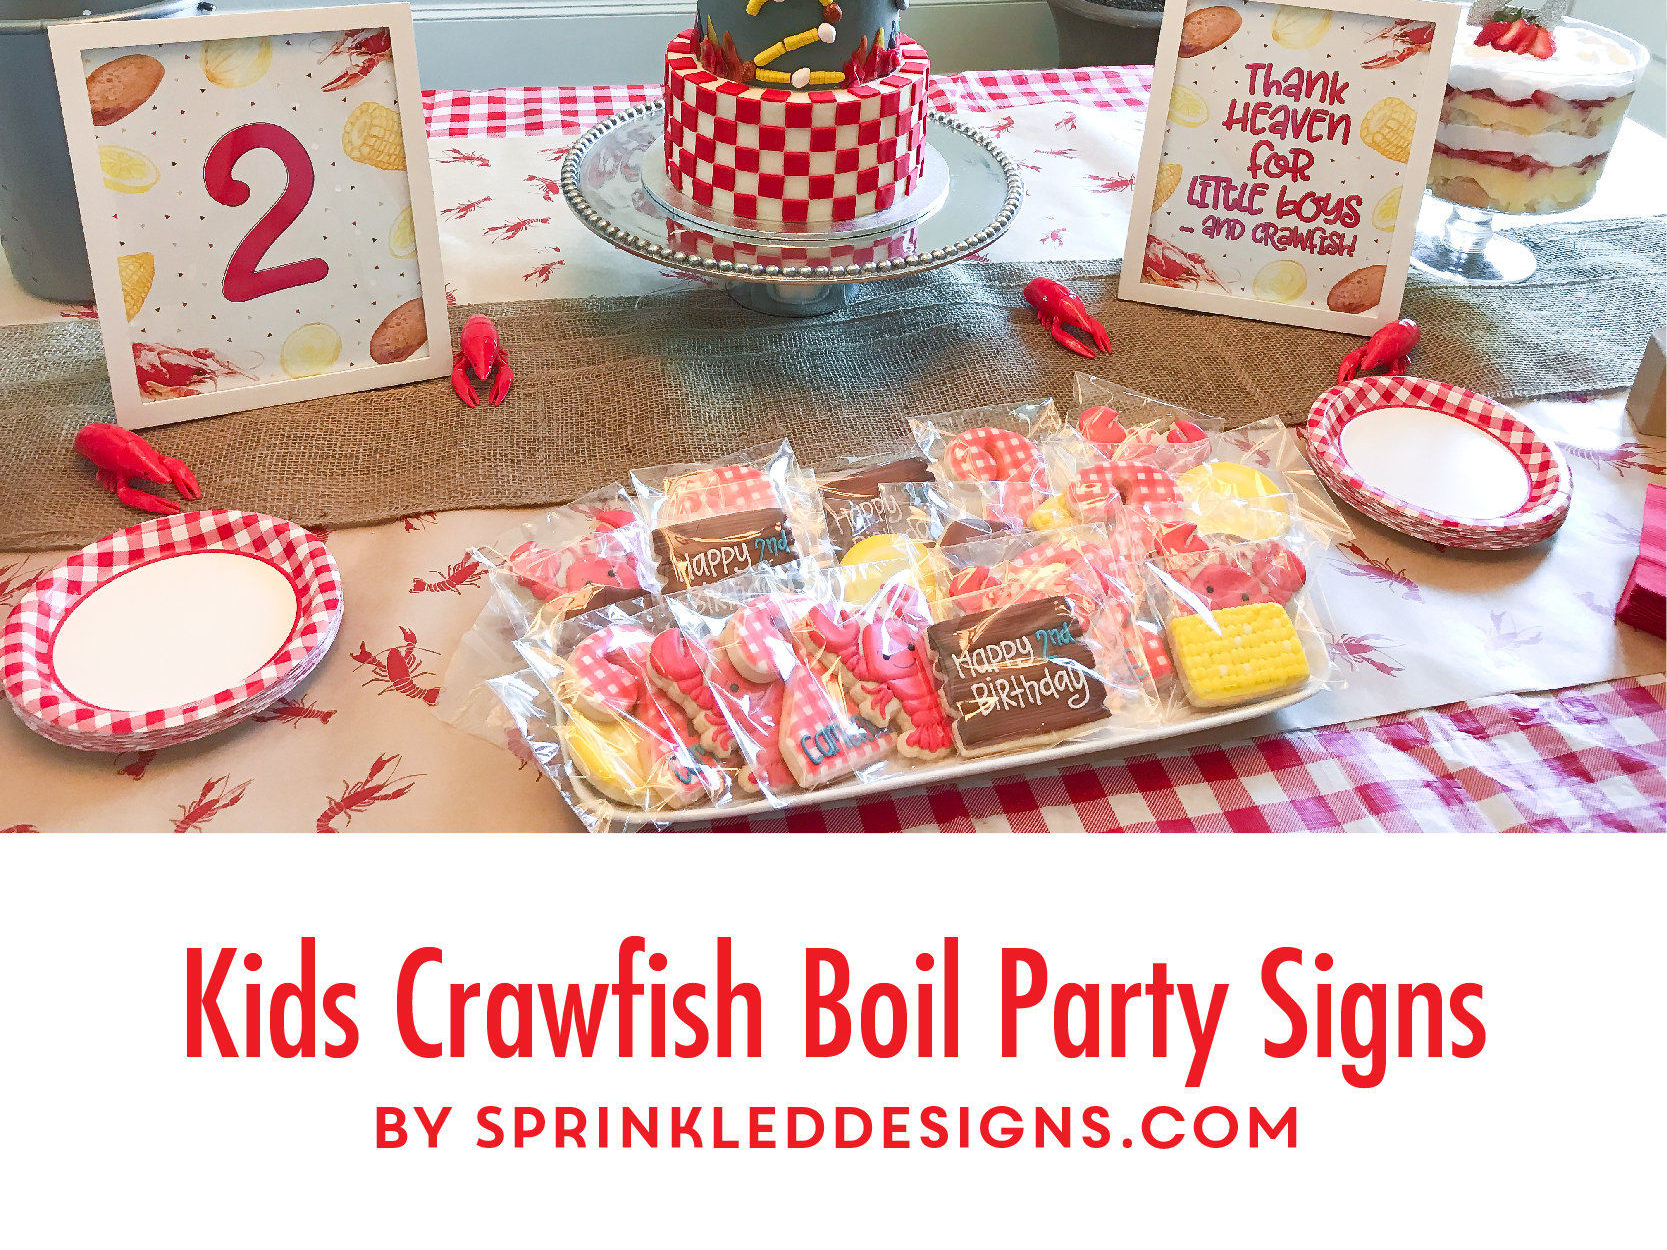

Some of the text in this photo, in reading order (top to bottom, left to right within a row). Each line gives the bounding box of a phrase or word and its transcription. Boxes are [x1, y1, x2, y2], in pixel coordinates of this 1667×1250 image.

[1244, 62, 1350, 106] Thank
[203, 121, 330, 303] 2
[951, 621, 1076, 679] Happy 2nd
